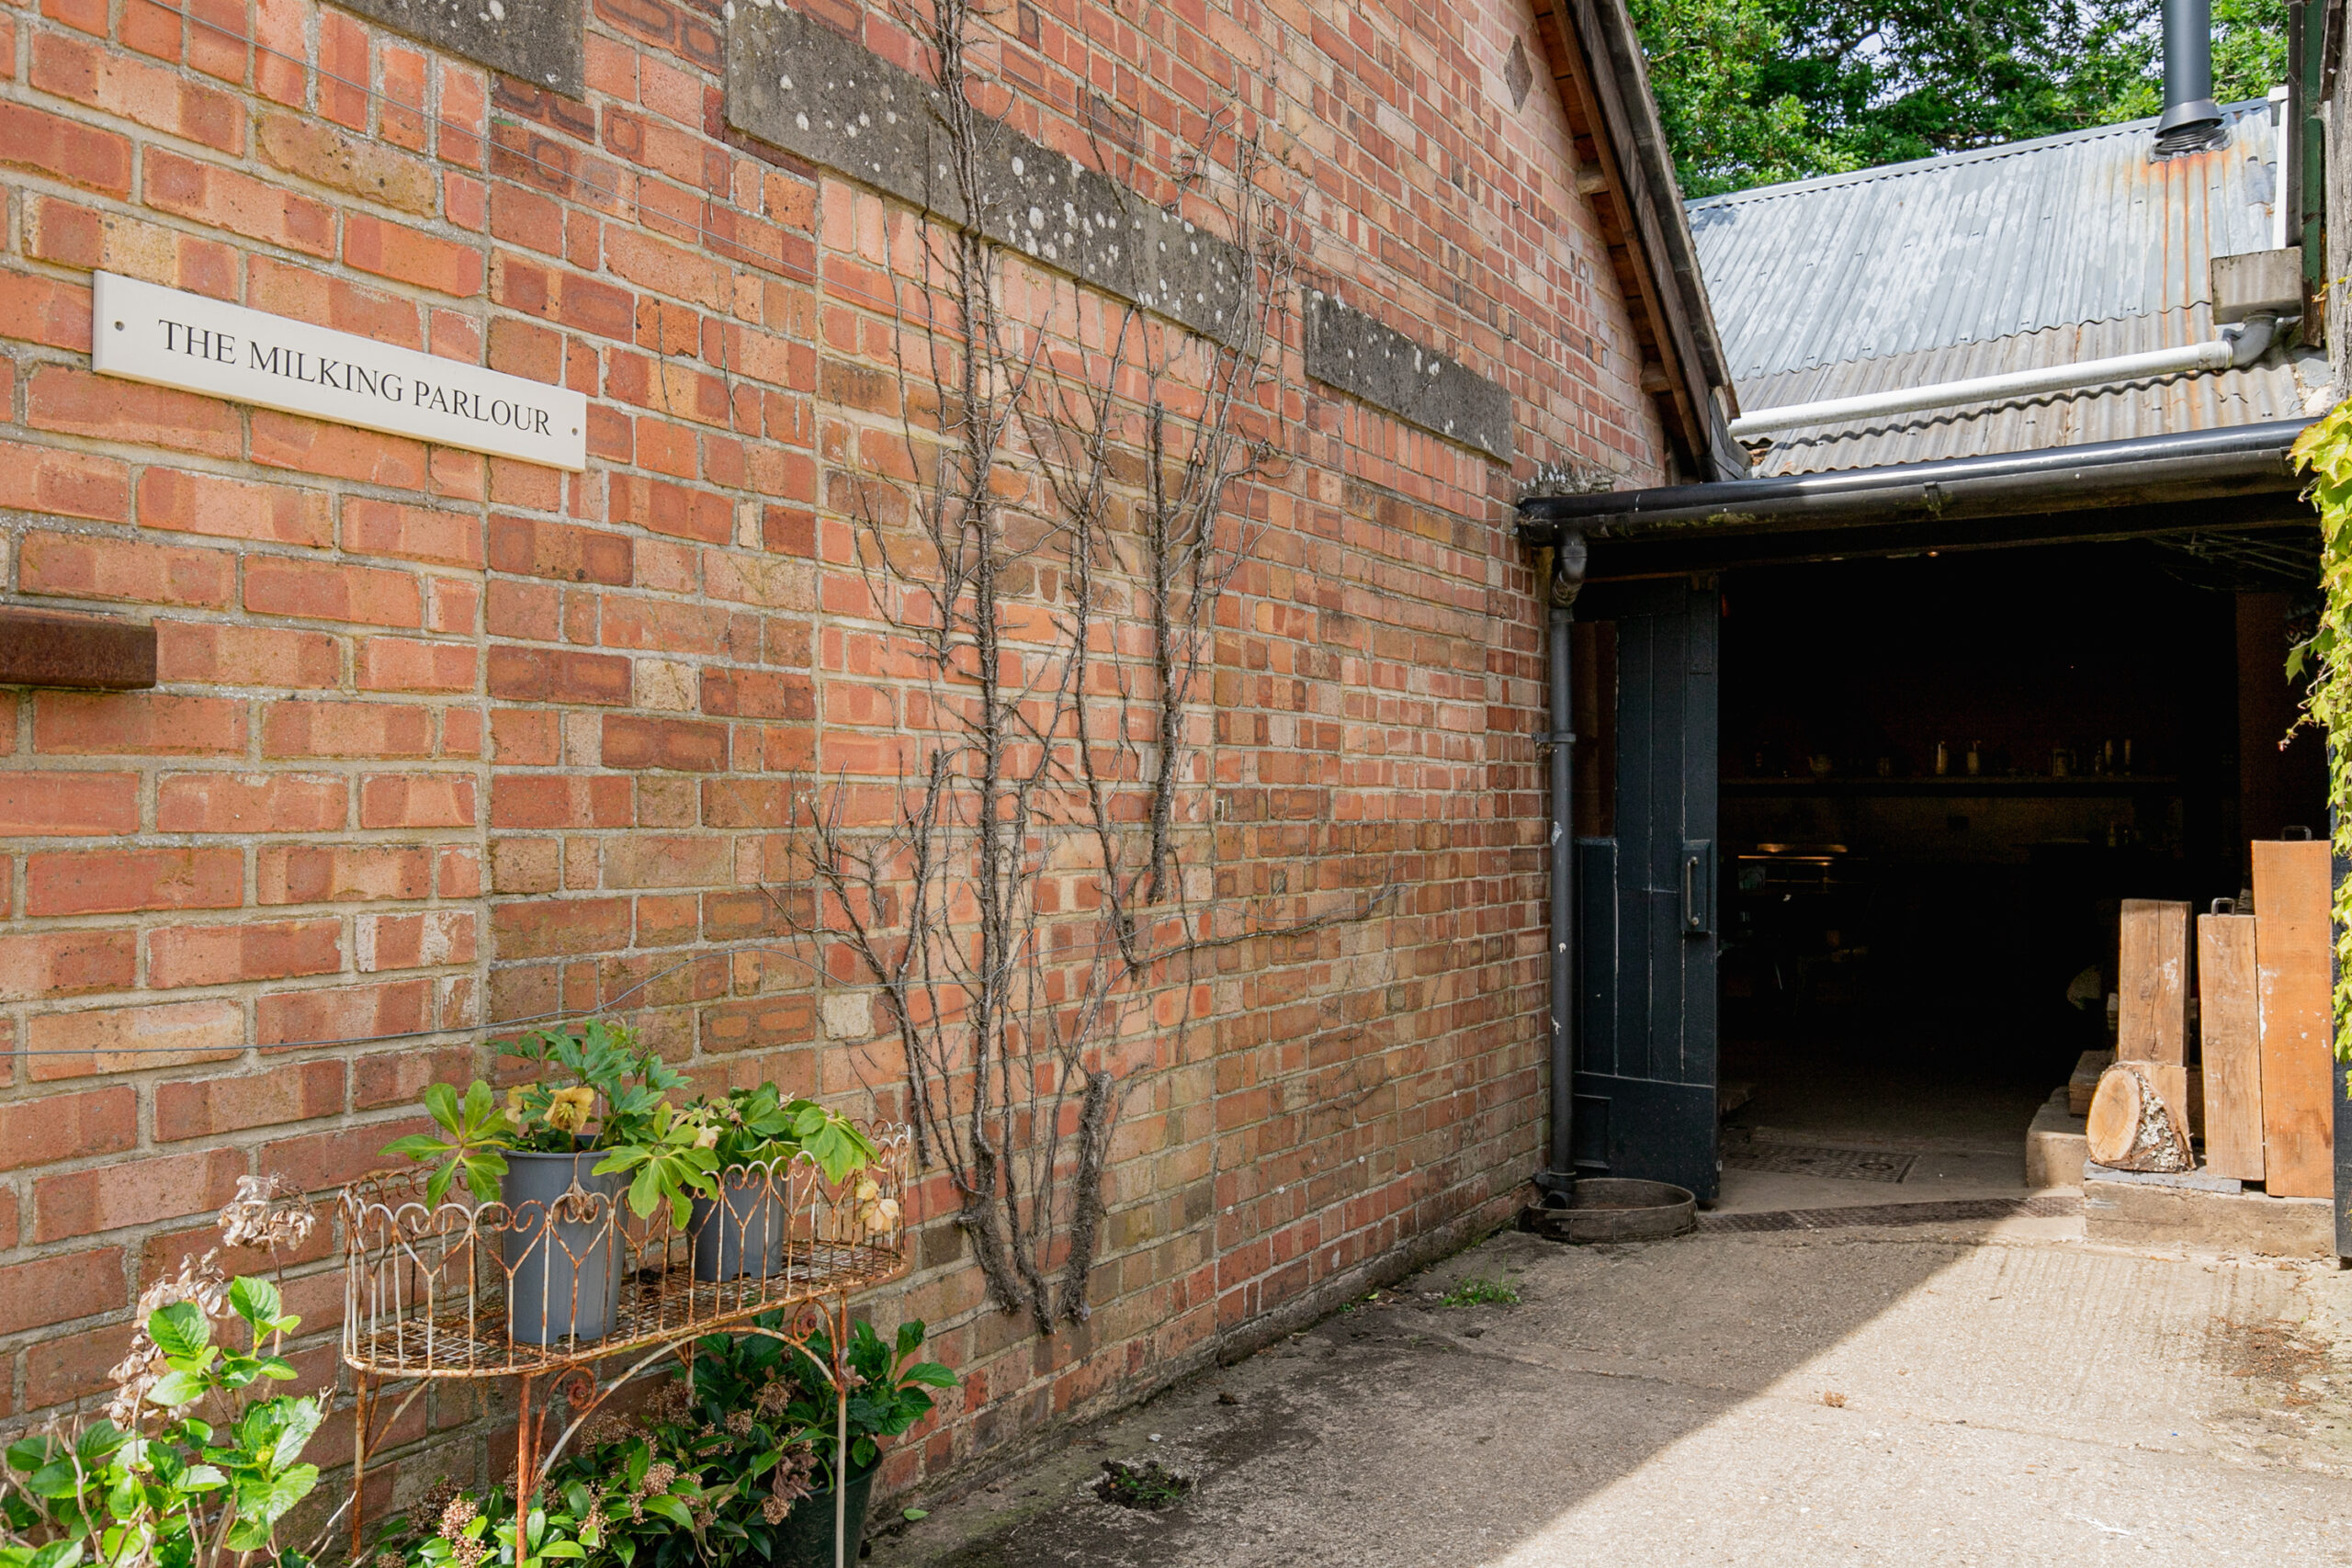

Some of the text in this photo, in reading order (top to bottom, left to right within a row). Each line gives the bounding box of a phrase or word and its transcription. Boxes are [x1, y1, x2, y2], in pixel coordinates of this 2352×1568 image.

[158, 319, 552, 437] THE MILKING PARLOUR
